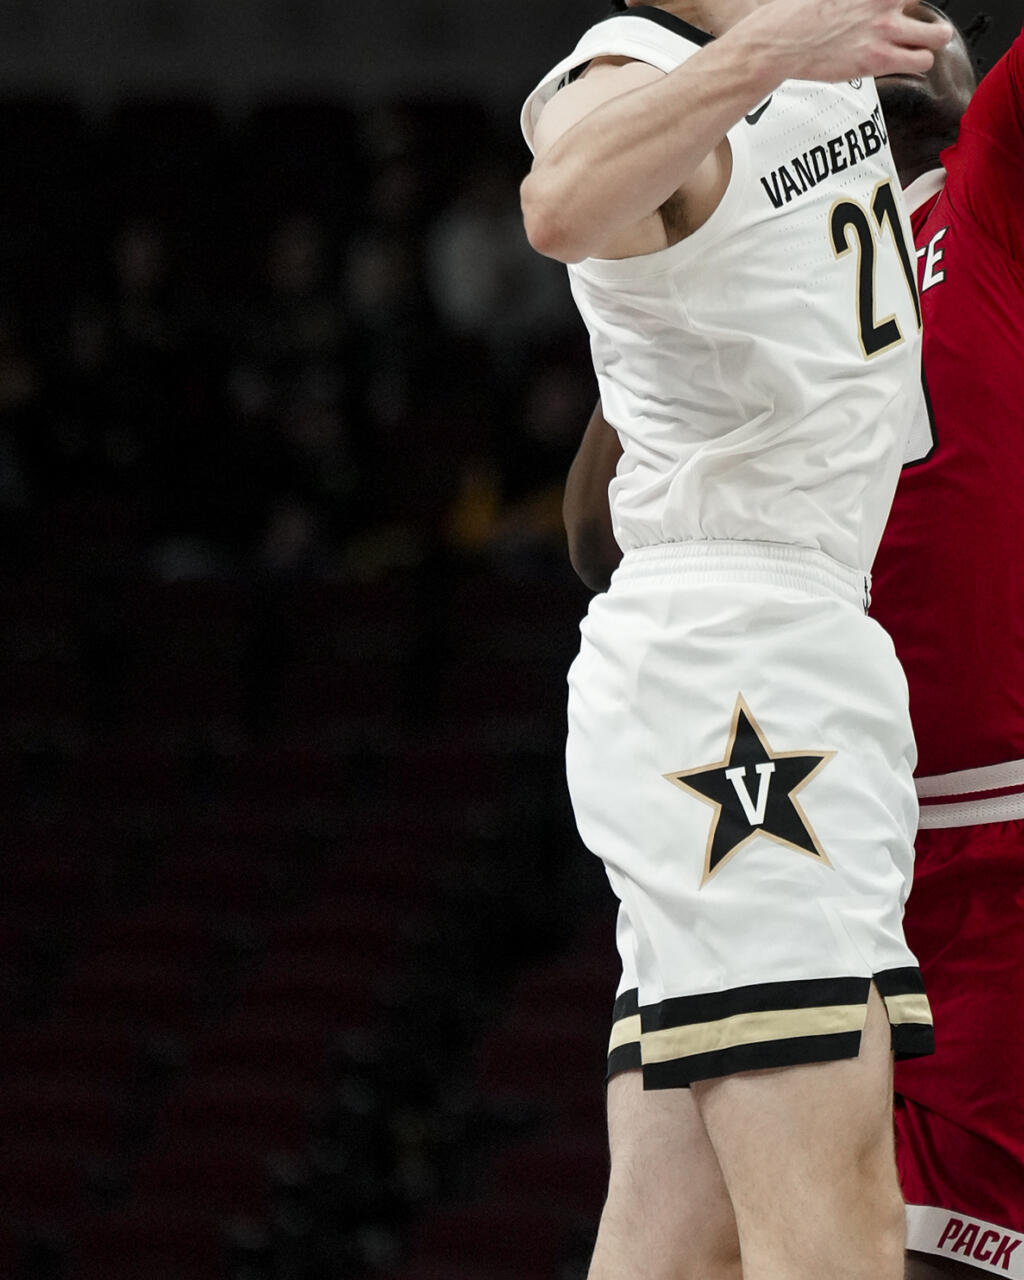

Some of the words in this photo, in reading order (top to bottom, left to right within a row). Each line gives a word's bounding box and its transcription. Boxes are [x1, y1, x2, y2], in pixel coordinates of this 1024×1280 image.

[828, 177, 923, 360] 21
[725, 762, 775, 826] V
[937, 1218, 1022, 1271] PACK
